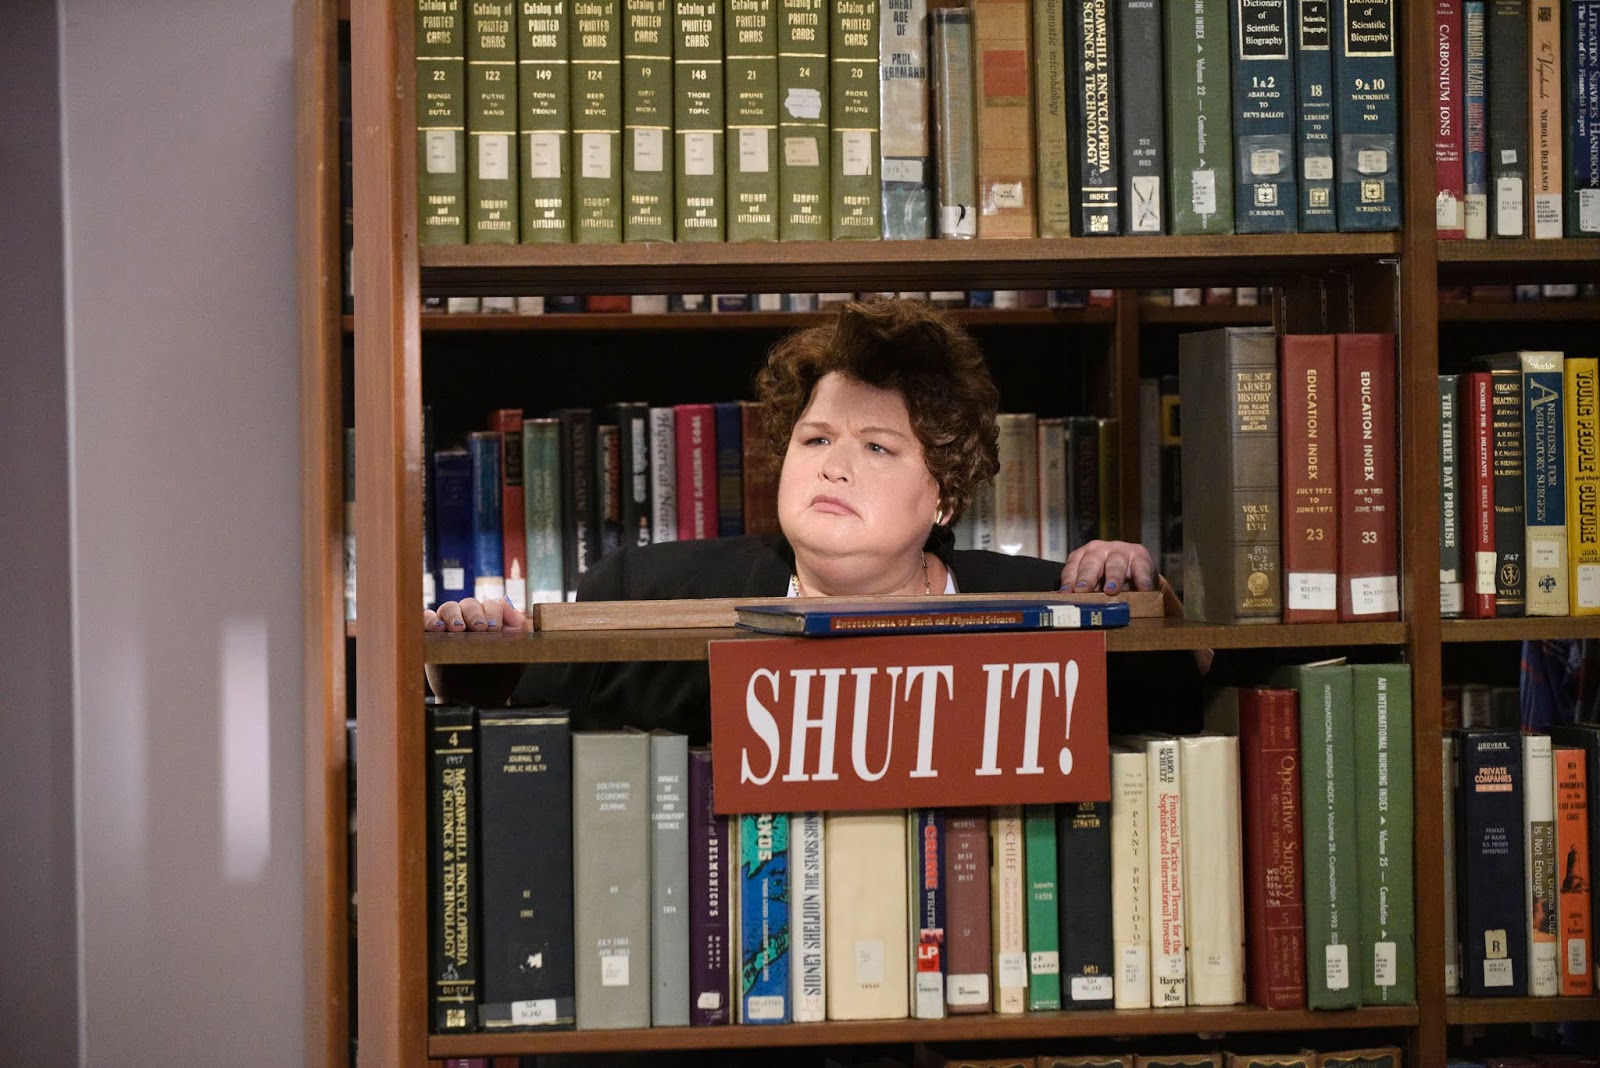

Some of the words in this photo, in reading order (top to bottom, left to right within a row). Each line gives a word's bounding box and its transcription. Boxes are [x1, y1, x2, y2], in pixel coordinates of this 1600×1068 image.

[419, 0, 446, 12] Catalog
[448, 0, 457, 11] of
[474, 3, 501, 17] Catalog
[503, 3, 512, 16] of
[524, 3, 552, 17] Catalog
[554, 3, 563, 15] of
[575, 3, 602, 17] Catalog
[605, 3, 613, 15] of
[657, 0, 665, 10] of
[677, 3, 704, 17] Catalog
[708, 3, 715, 15] of
[732, 0, 759, 12] Catalog
[761, 0, 769, 10] of
[813, 0, 821, 8] of
[837, 2, 864, 15] Catalog
[867, 2, 875, 14] of
[894, 12, 908, 23] AGE
[1258, 11, 1267, 19] of
[1364, 7, 1373, 16] of
[1578, 4, 1586, 20] The
[423, 16, 454, 29] PRINTED
[478, 20, 508, 33] PRINTED
[529, 20, 559, 32] PRINTED
[579, 20, 610, 32] PRINTED
[631, 15, 662, 28] PRINTED
[682, 20, 712, 32] PRINTED
[736, 15, 765, 27] PRINTED
[788, 13, 818, 26] PRINTED
[841, 18, 871, 31] PRINTED
[1352, 19, 1386, 29] Scientific
[791, 28, 815, 41] CARDS
[897, 24, 906, 36] OF
[1082, 2, 1096, 58] SCIENCE
[1195, 16, 1205, 39] INDEX
[1246, 23, 1280, 33] Scientific
[427, 31, 451, 44] CARDS
[481, 36, 505, 48] CARDS
[532, 35, 557, 47] CARDS
[582, 35, 607, 47] CARDS
[634, 31, 658, 44] CARDS
[685, 35, 709, 47] CARDS
[739, 31, 763, 43] CARDS
[844, 34, 868, 46] CARDS
[1246, 35, 1283, 46] Biography
[1351, 32, 1389, 43] Biography
[892, 53, 912, 65] PAUL
[1084, 61, 1096, 71] &
[1439, 24, 1451, 101] CARBONIUM
[433, 71, 445, 81] 22
[485, 71, 500, 80] 122
[536, 70, 552, 80] 149
[588, 71, 602, 80] 124
[642, 68, 651, 77] 19
[692, 70, 707, 80] 148
[747, 71, 756, 80] 21
[800, 68, 810, 77] 24
[851, 68, 863, 78] 20
[1196, 58, 1206, 83] Volume
[1048, 51, 1061, 116] microbiology
[1197, 85, 1206, 95] 22
[1310, 84, 1322, 97] 18
[1579, 68, 1587, 106] Financial
[1084, 75, 1098, 166] TECHNOLOGY
[1096, 73, 1111, 173] ENCYCLOPEDIA
[1440, 106, 1451, 136] IONS
[1577, 109, 1586, 136] Expert
[1197, 115, 1207, 153] Cumulation
[1089, 192, 1110, 201] INDEX
[1237, 373, 1252, 381] THE
[1254, 372, 1272, 381] NEW
[1237, 382, 1272, 392] LARNED
[1576, 370, 1594, 416] YOUNG
[1237, 392, 1271, 402] HISTORY
[1306, 369, 1318, 438] EDUCATION
[1360, 371, 1373, 439] EDUCATION
[1442, 393, 1452, 418] THE
[1442, 421, 1453, 463] THREE
[1577, 419, 1596, 472] PEOPLE
[1307, 443, 1318, 480] INDEX
[1363, 444, 1375, 481] INDEX
[1443, 466, 1454, 489] DAY
[1547, 465, 1556, 486] FOR
[1536, 474, 1546, 522] SURGERY
[1443, 492, 1455, 547] PROMISE
[1578, 483, 1597, 544] CULTURE
[1306, 529, 1324, 540] 23
[1361, 532, 1378, 544] 33
[836, 618, 896, 629] ENCYCLOPEDIA
[910, 617, 932, 626] Earth
[935, 616, 951, 625] and
[953, 615, 983, 627] Physical
[986, 614, 1017, 624] Sciences
[1324, 684, 1333, 743] INTERNATIONAL
[740, 664, 954, 785] SHUT
[975, 659, 1079, 776] IT!
[1378, 692, 1388, 750] INTERNATIONAL
[448, 732, 459, 746] 4
[511, 745, 539, 753] AMERICAN
[1158, 748, 1167, 783] SCHULTZ
[1166, 748, 1174, 775] HARRY
[1325, 744, 1335, 779] NURSING
[1378, 752, 1388, 787] NURSING
[1479, 767, 1508, 776] PRIVATE
[442, 769, 455, 786] OF
[1474, 775, 1512, 784] COMPANIES
[1276, 755, 1296, 833] Operative
[1327, 780, 1335, 803] INDEX
[1379, 788, 1389, 811] INDEX
[442, 789, 456, 848] SCIENCE
[454, 768, 468, 860] McGRAW-HILL
[1169, 794, 1179, 838] Financial
[1072, 819, 1101, 828] STRAYER
[1157, 793, 1169, 855] Sophisticated
[1327, 811, 1336, 840] Volume
[1379, 829, 1388, 854] Volume
[1534, 838, 1543, 856] Not
[443, 850, 455, 862] &
[804, 839, 819, 871] STARS
[924, 825, 938, 891] CRIME
[1170, 840, 1180, 872] Tactics
[708, 838, 719, 917] DELMONICO'S
[1280, 841, 1298, 900] Surgery
[804, 872, 819, 892] THE
[1171, 874, 1180, 890] and
[1329, 856, 1338, 901] Cumulation
[1532, 860, 1544, 898] Enough
[1161, 857, 1171, 916] International
[442, 864, 456, 959] TECHNOLOGY
[1171, 892, 1181, 921] Terms
[1379, 886, 1389, 925] Cumulation
[456, 863, 469, 966] ENCYCLOPEDIA
[802, 894, 821, 949] SHELDON
[1162, 919, 1172, 955] Investor
[1172, 924, 1182, 937] for
[918, 946, 938, 959] LP
[1173, 940, 1182, 955] the
[1492, 941, 1500, 952] R
[803, 951, 821, 996] SIDNEY
[1159, 977, 1185, 988] Harper
[1164, 993, 1181, 1002] Row
